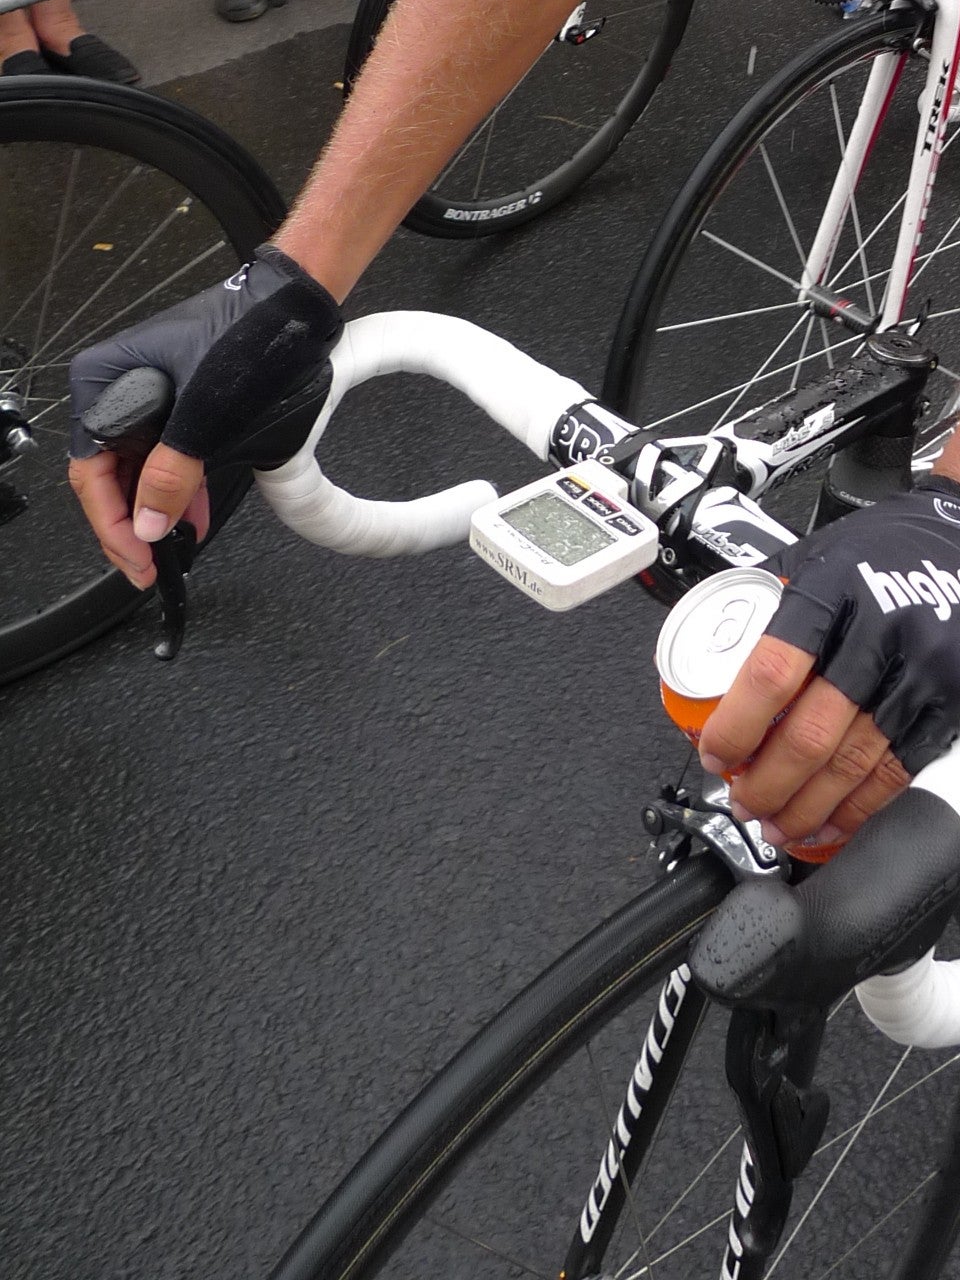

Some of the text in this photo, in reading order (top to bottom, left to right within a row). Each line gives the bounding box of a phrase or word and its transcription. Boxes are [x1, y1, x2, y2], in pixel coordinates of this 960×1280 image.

[920, 57, 951, 157] TREK
[443, 198, 528, 221] BONTRAGER
[474, 537, 545, 597] www.SRM.de
